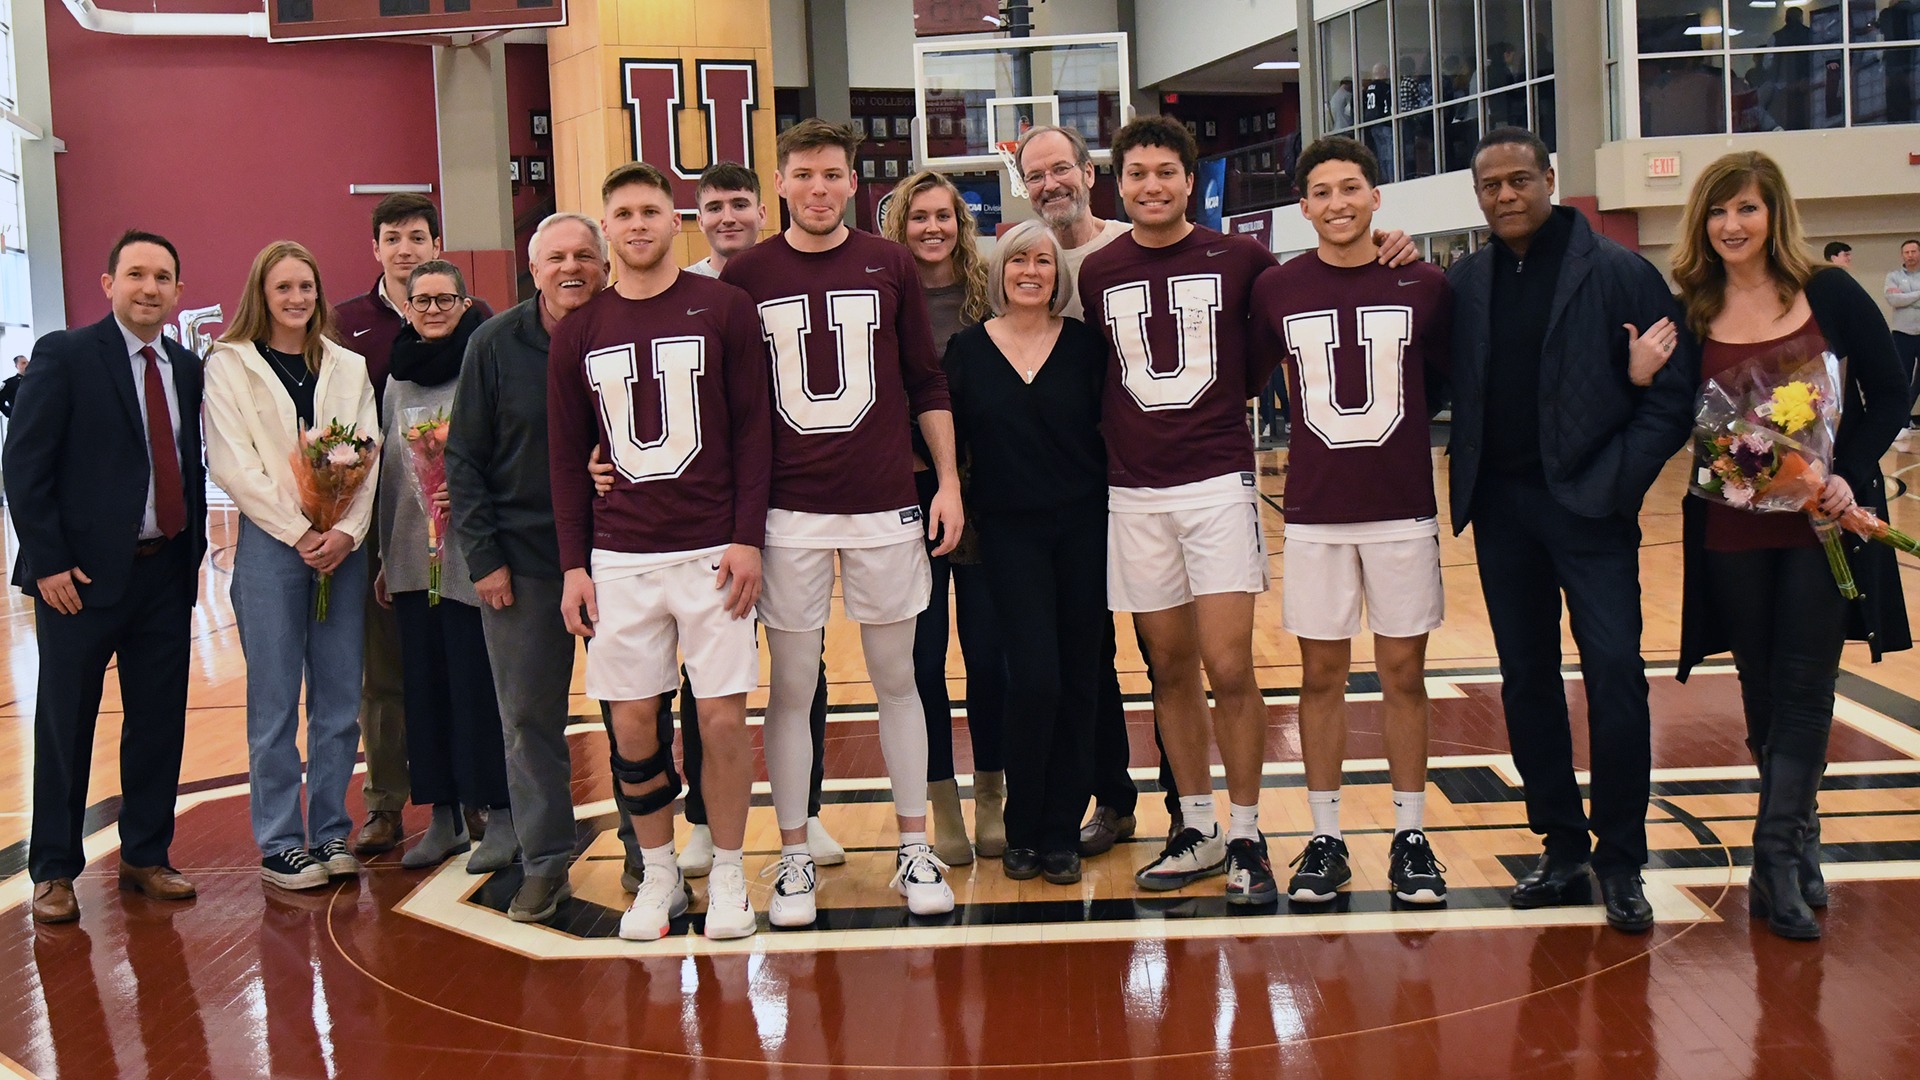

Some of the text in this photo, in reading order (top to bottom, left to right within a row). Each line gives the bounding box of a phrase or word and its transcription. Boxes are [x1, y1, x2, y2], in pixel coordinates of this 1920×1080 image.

[619, 58, 759, 220] U
[851, 97, 865, 107] ON
[1366, 92, 1376, 110] 20
[1653, 158, 1675, 174] EXIT
[967, 203, 982, 212] CAA
[585, 336, 705, 483] U
[757, 290, 880, 435] U
[1103, 273, 1222, 412] U
[1283, 305, 1413, 449] U
